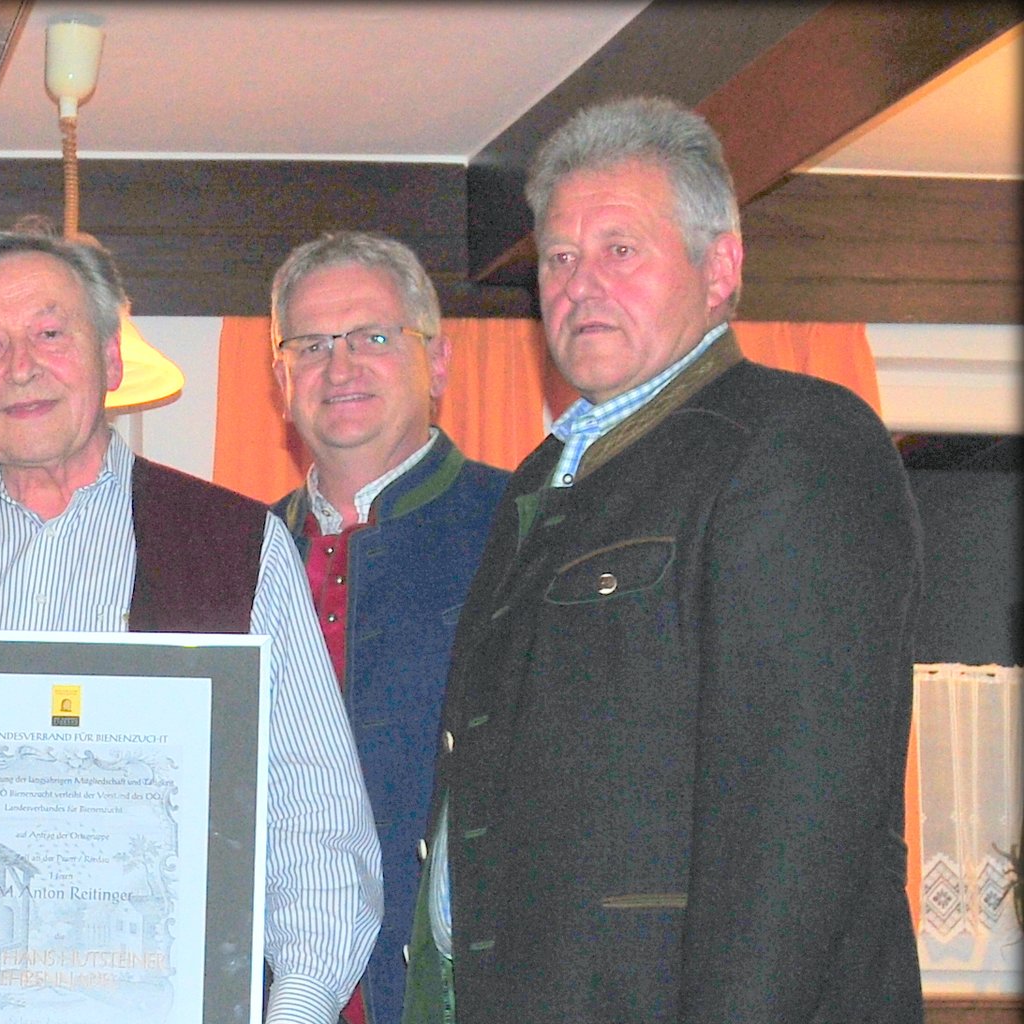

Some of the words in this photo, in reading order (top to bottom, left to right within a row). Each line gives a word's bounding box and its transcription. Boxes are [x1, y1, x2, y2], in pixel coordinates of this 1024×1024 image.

[75, 731, 94, 742] FÜR
[96, 734, 169, 744] BIENENZUCHT
[15, 775, 27, 784] der
[74, 777, 127, 787] Mitgliedschaft
[128, 778, 141, 786] und
[9, 789, 53, 799] Bienenzucht
[83, 791, 95, 800] der
[4, 804, 66, 813] Landesverbandes
[79, 805, 123, 815] Bienenzucht
[29, 831, 55, 841] Antrag
[57, 831, 69, 840] der
[19, 884, 65, 900] Anton
[70, 886, 134, 905] Reitinger
[2, 949, 56, 968] HANS
